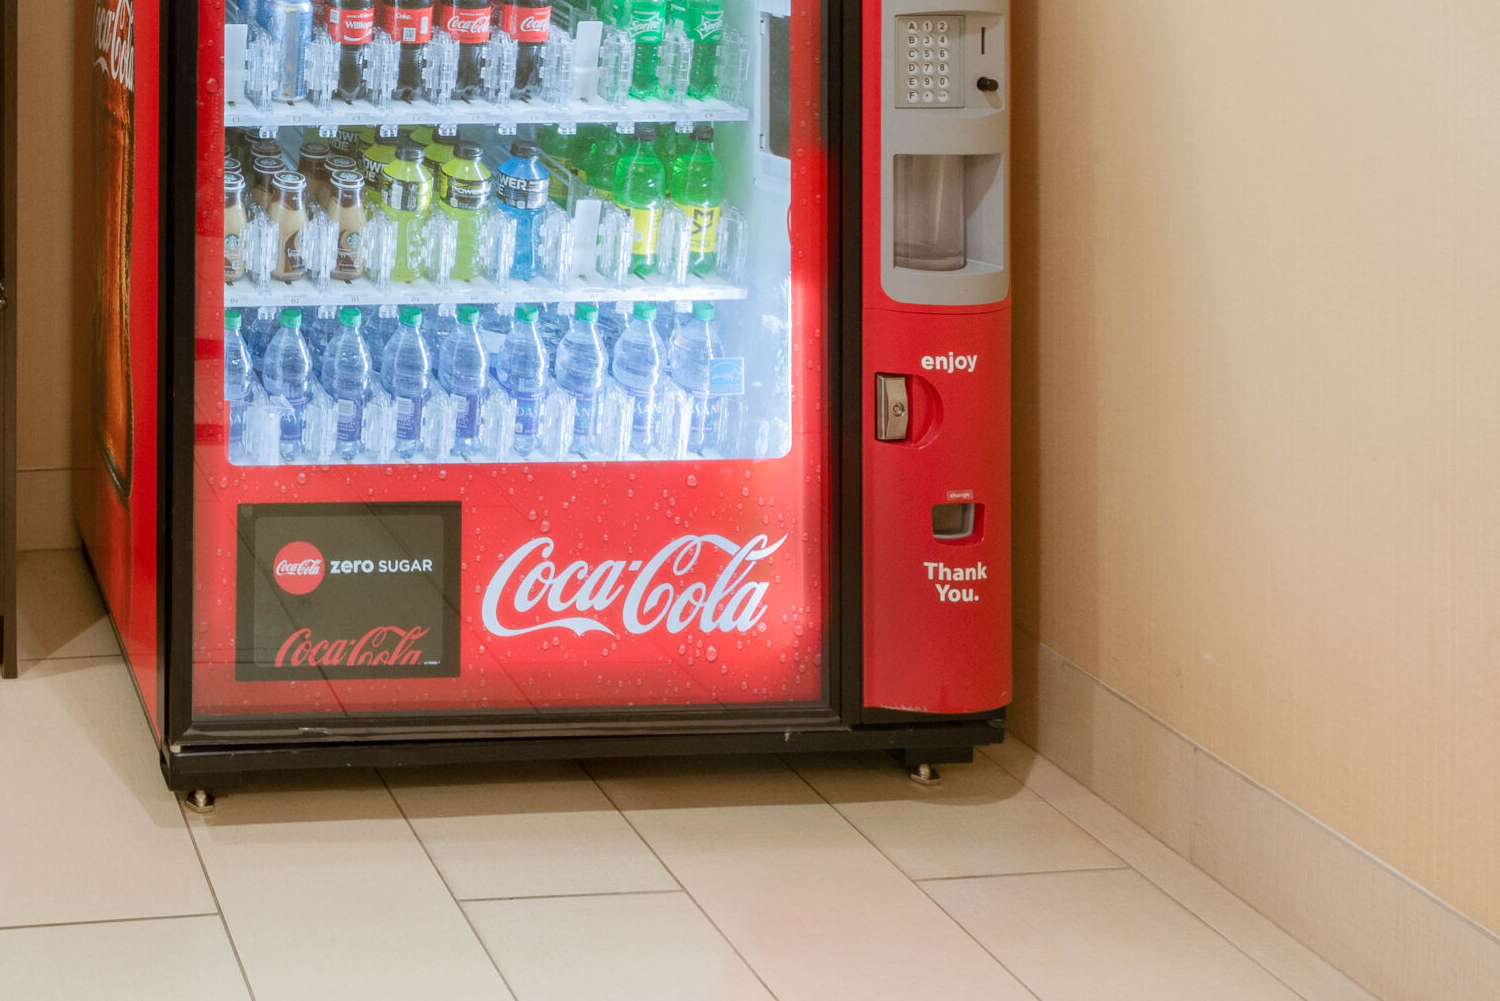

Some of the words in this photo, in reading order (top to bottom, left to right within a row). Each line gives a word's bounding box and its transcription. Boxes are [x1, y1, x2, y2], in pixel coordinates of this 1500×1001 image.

[921, 352, 978, 373] enjoy
[276, 558, 324, 576] Coca-Cola
[330, 560, 375, 574] zero
[378, 559, 433, 573] SUGAR
[924, 562, 988, 582] Thank
[482, 534, 788, 637] Coca-Cola
[935, 584, 980, 602] You.
